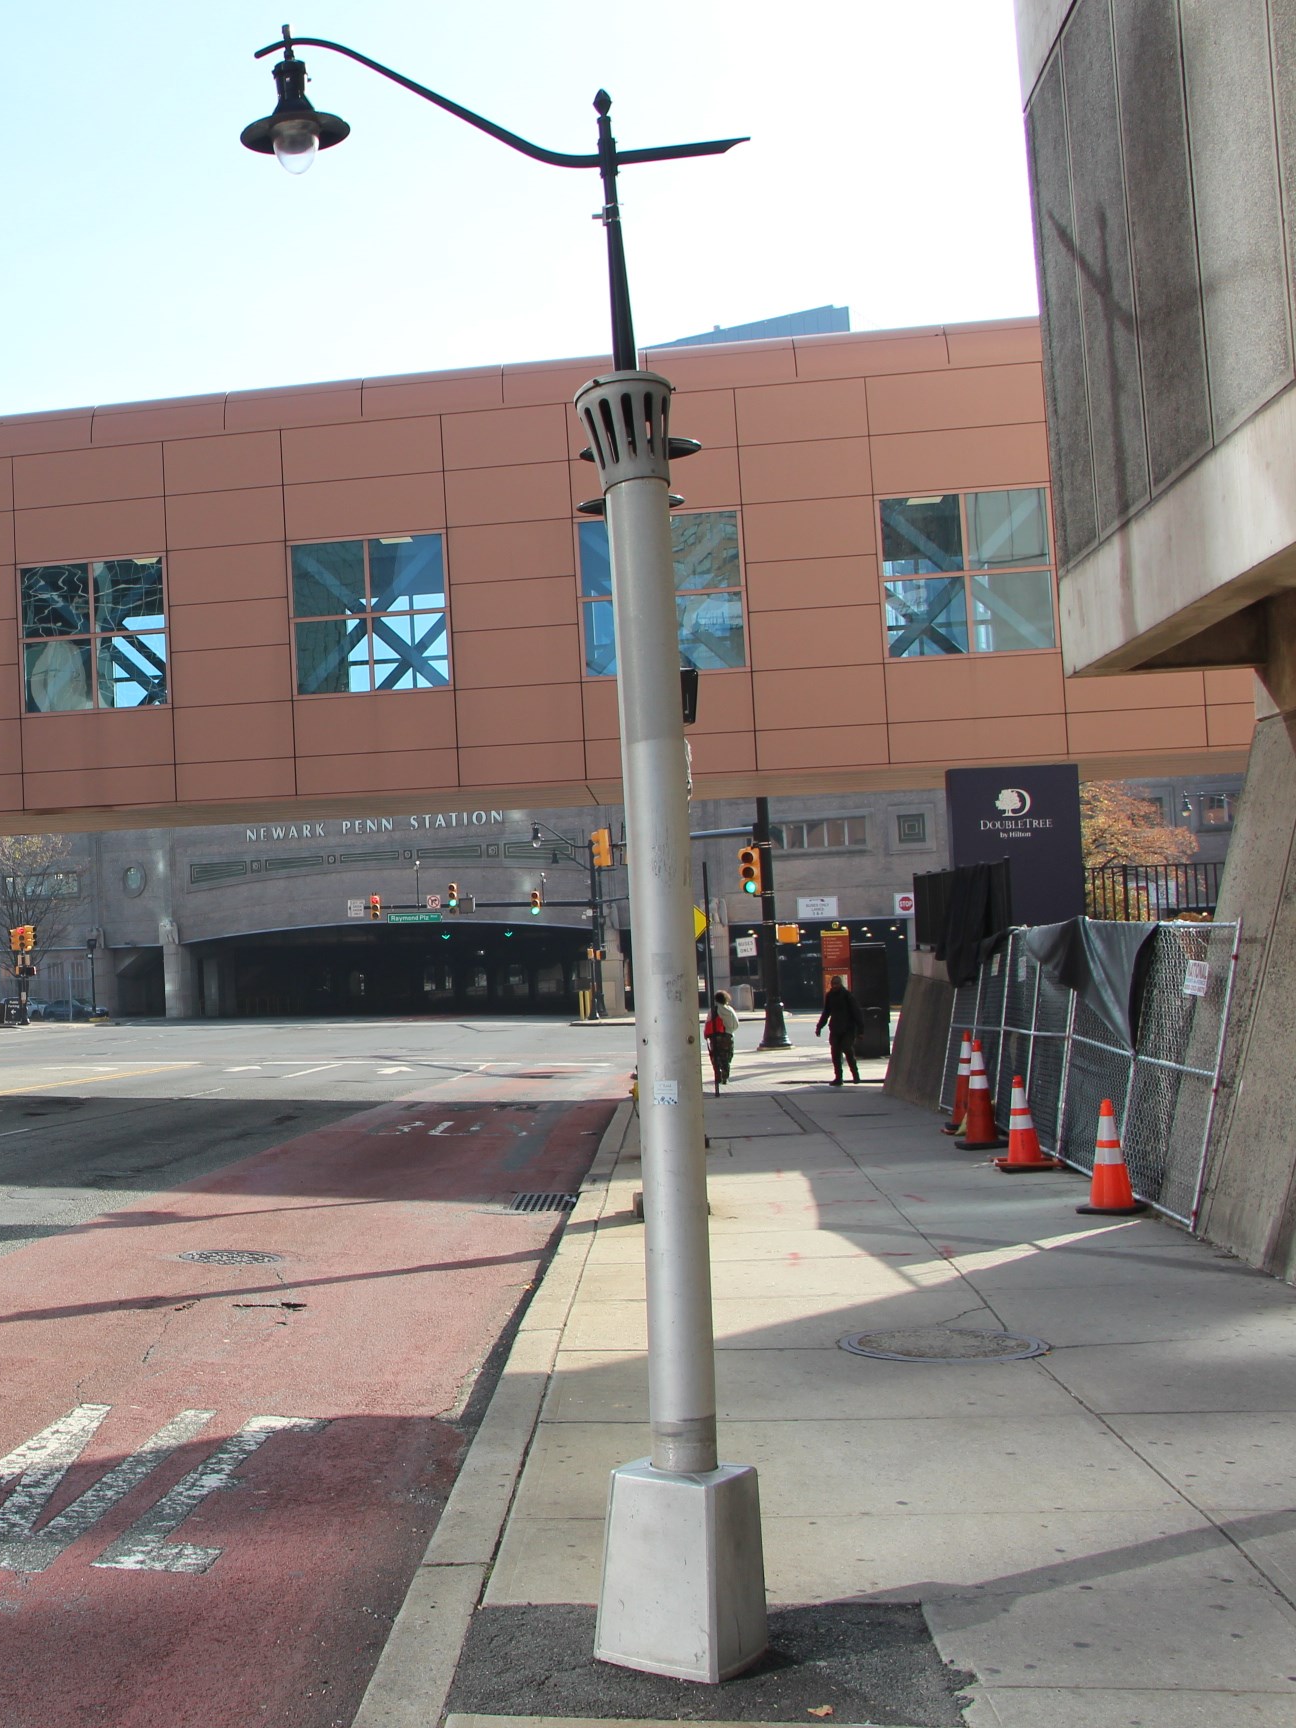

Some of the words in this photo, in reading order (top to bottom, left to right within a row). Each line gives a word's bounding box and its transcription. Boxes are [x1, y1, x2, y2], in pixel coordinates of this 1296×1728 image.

[245, 822, 325, 843] NEWARK
[342, 817, 394, 834] PENN
[409, 810, 505, 830] STATION
[1000, 831, 1008, 839] by
[899, 900, 913, 908] STOP
